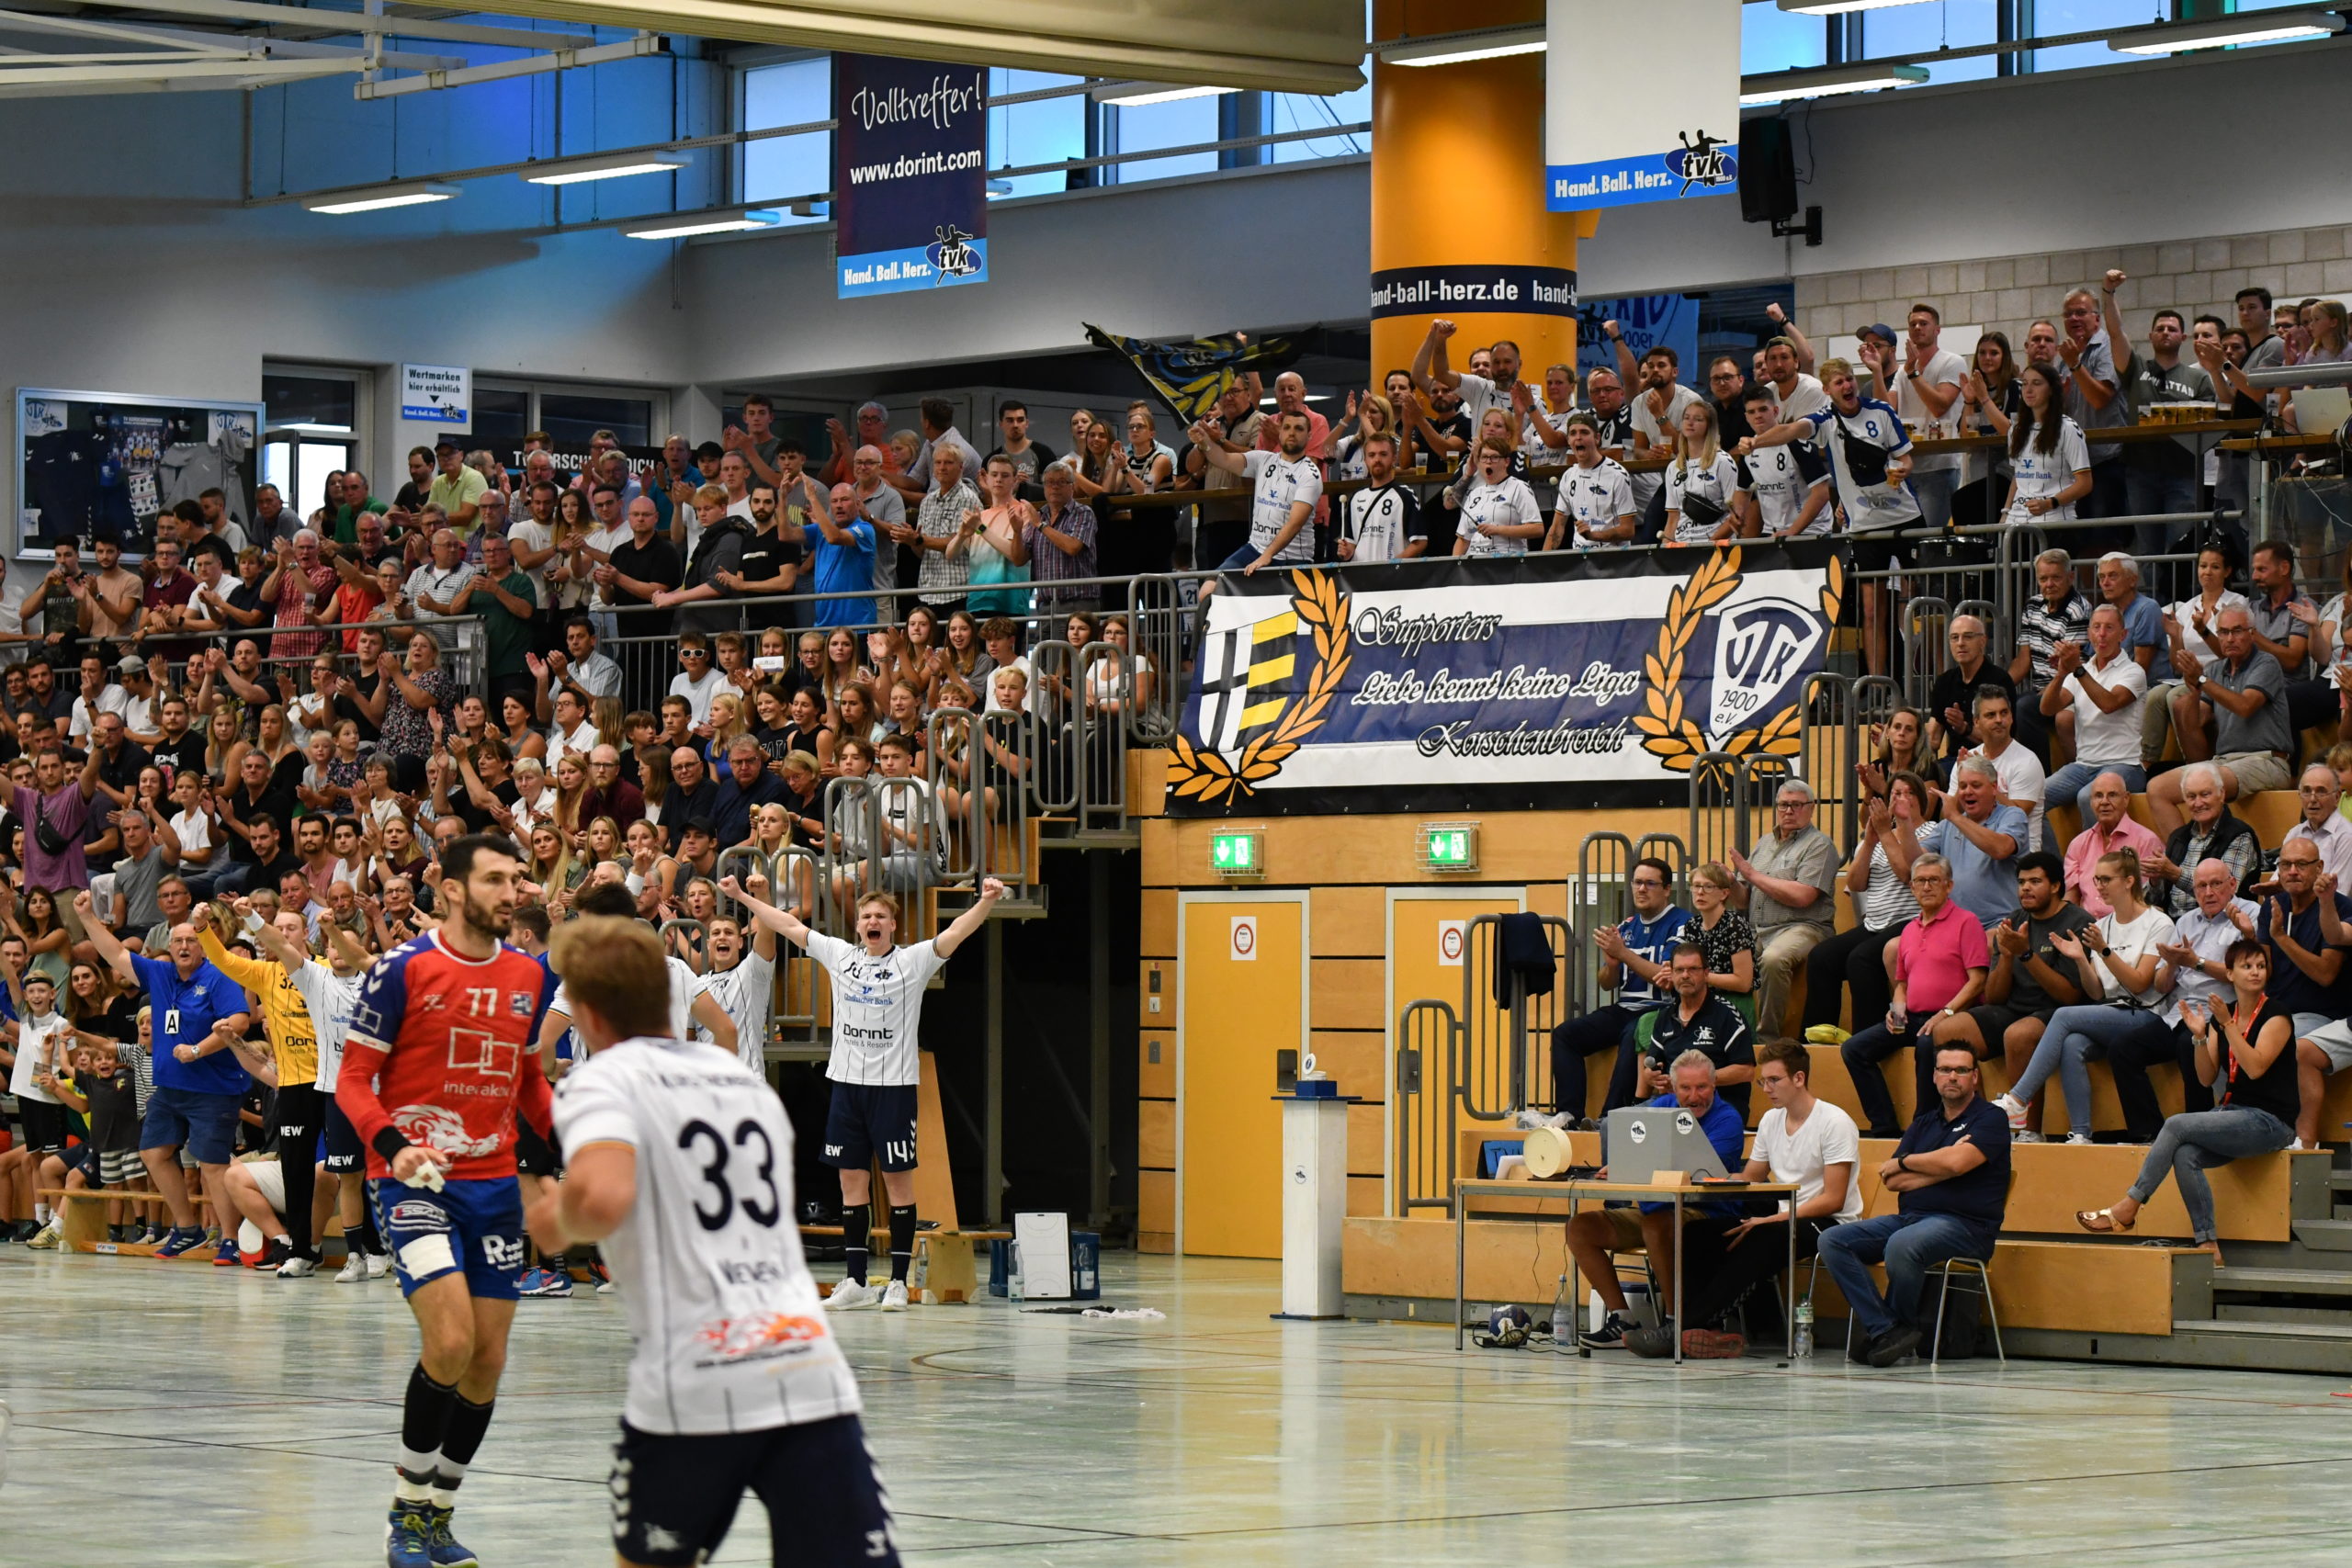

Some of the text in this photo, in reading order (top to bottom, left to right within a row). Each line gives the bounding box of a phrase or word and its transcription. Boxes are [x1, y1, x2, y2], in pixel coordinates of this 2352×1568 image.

[852, 73, 981, 130] Volltreffer!
[850, 150, 981, 185] www.dorint.com
[1683, 151, 1723, 178] tvk
[1555, 170, 1672, 197] Hand. Ball. Herz.
[940, 243, 968, 268] tvk
[844, 261, 932, 286] Hand. Ball. Herz.
[409, 368, 460, 381] Wertmarken
[409, 381, 424, 390] hier
[1865, 421, 1878, 438] 8
[1265, 464, 1276, 478] 8
[1777, 452, 1785, 471] 8
[1569, 479, 1577, 497] 8
[1382, 499, 1393, 515] 8
[1186, 589, 1198, 604] 21
[1355, 605, 1502, 658] Supporters
[1351, 660, 1641, 706] Liebe kennt keine Liga
[1719, 690, 1758, 712] 1900
[1416, 716, 1629, 758] Korschenbroich
[466, 987, 498, 1017] 77
[875, 997, 893, 1006] Bank
[166, 1014, 177, 1032] A
[843, 1023, 893, 1040] Dorint
[328, 1155, 354, 1167] NEW
[887, 1140, 908, 1165] 14
[678, 1118, 781, 1232] 33
